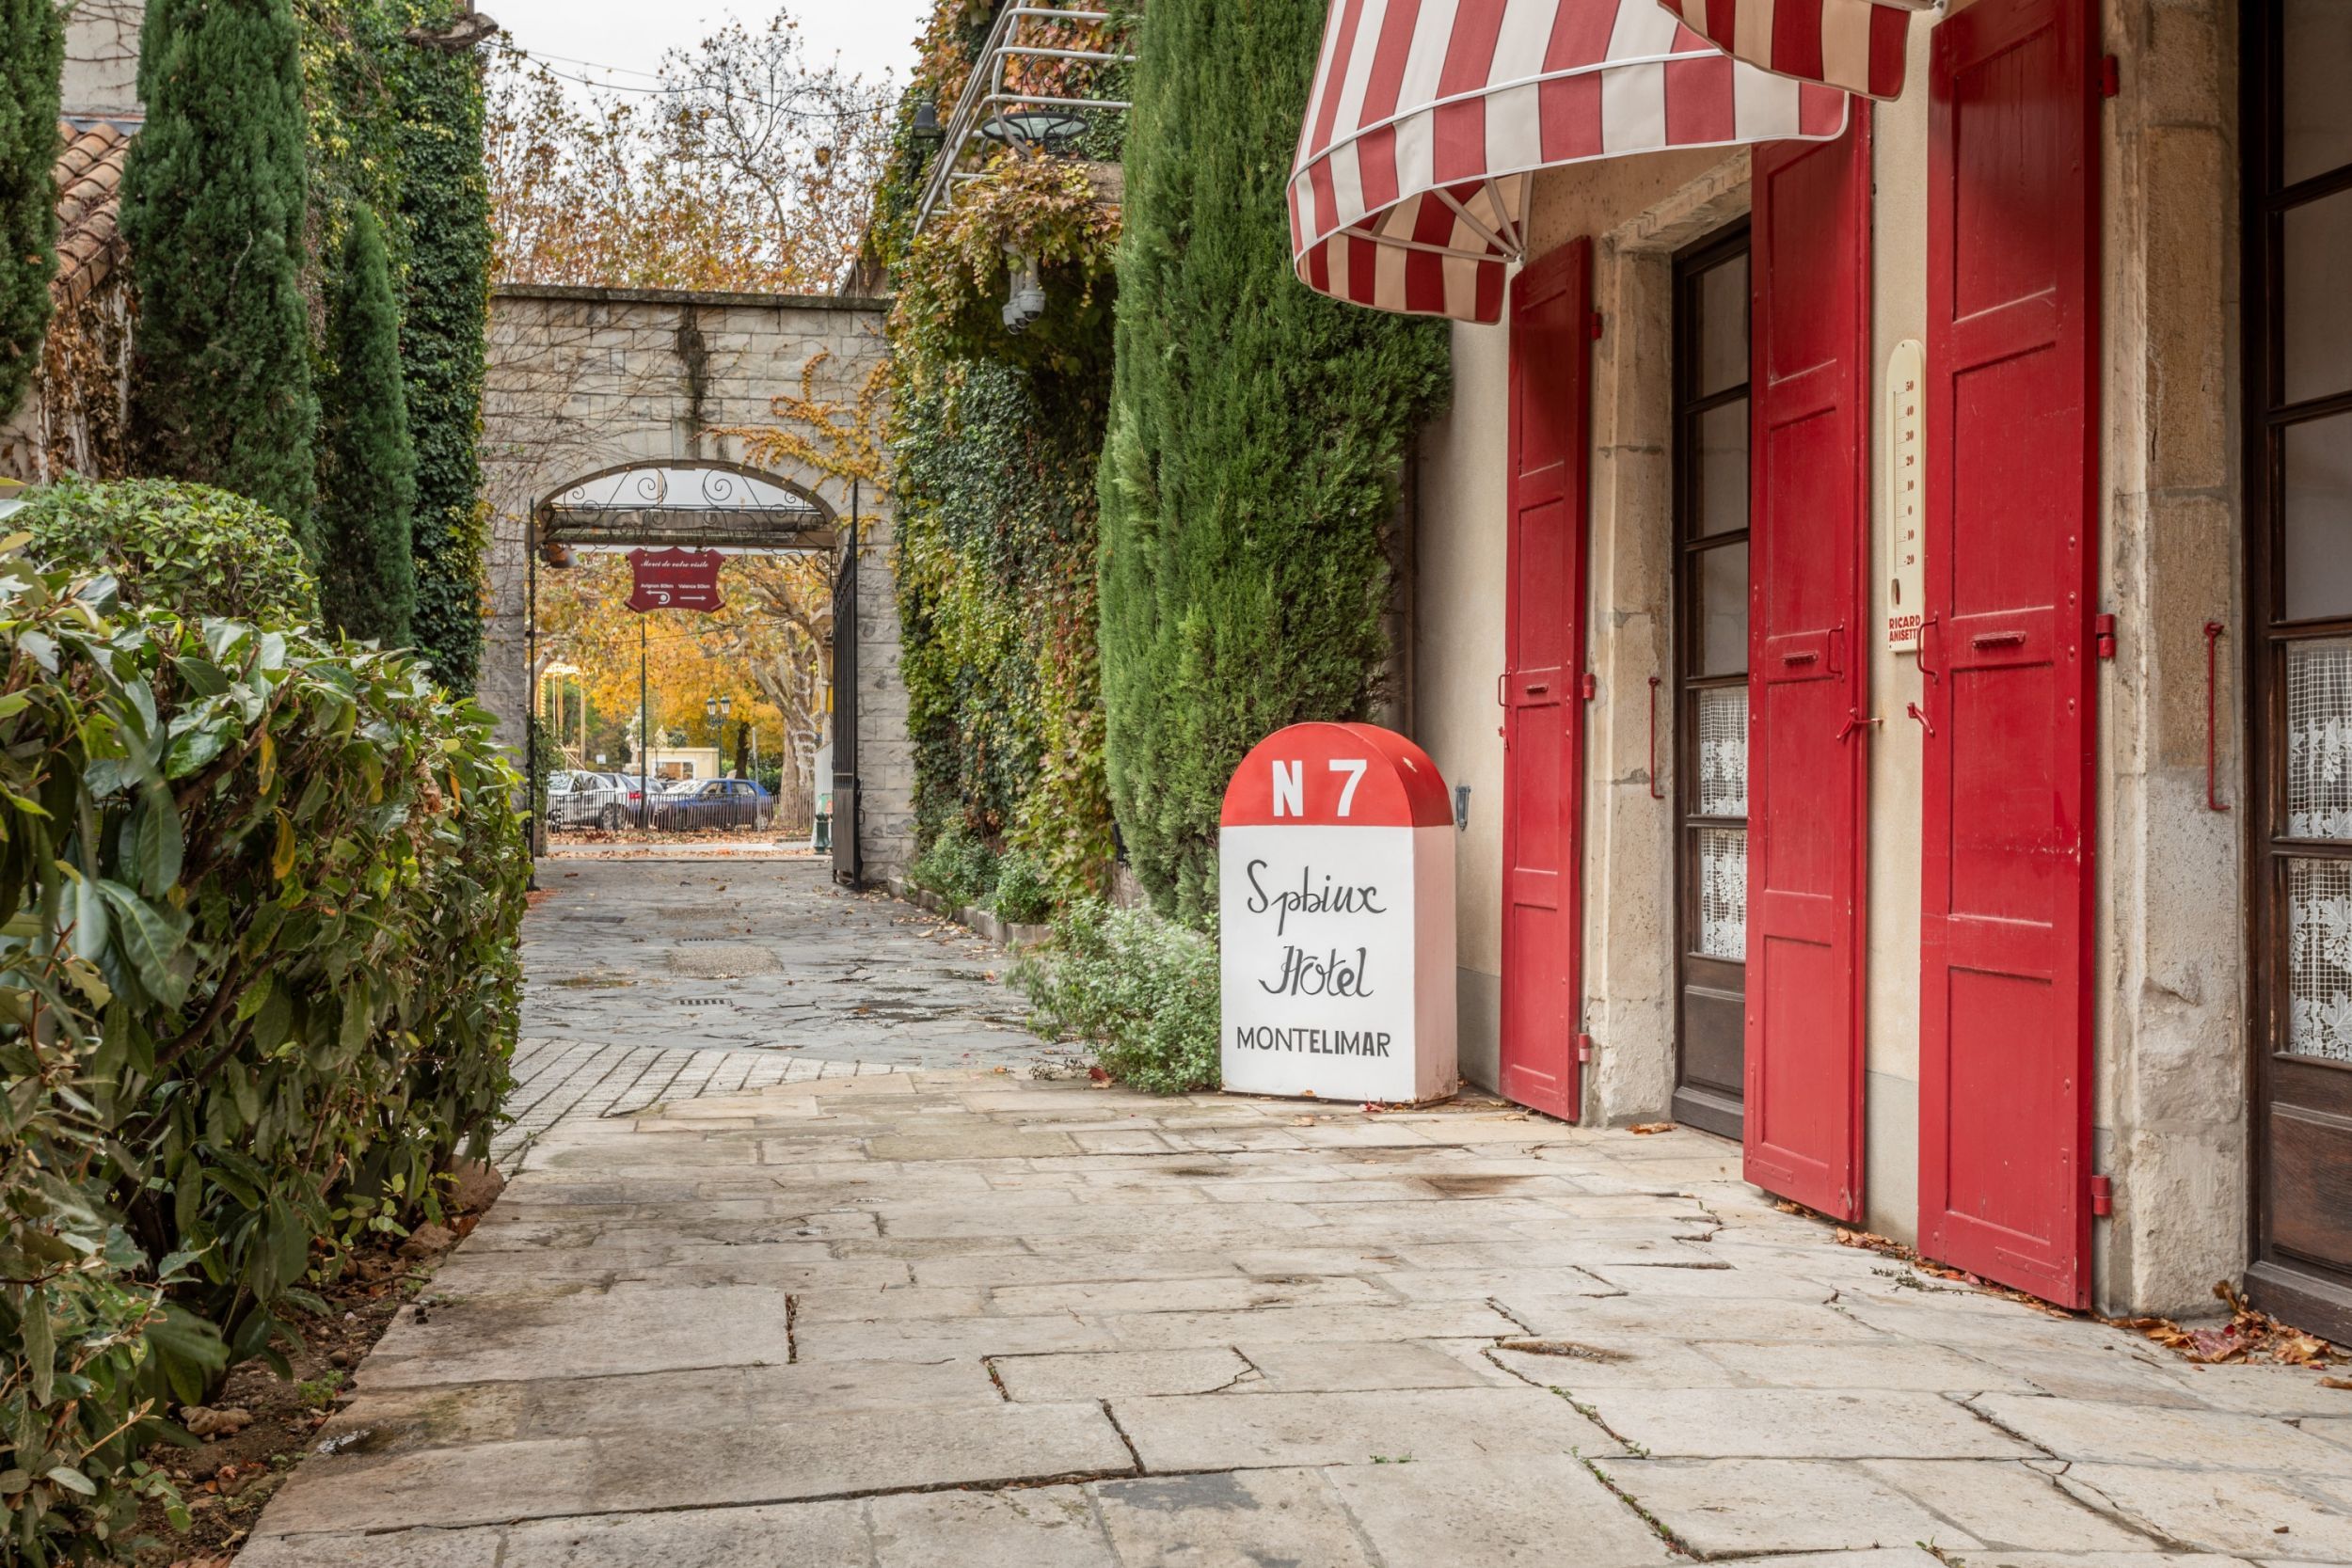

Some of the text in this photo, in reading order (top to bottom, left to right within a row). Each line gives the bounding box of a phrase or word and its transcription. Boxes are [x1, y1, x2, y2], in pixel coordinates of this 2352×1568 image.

[1906, 380, 1914, 391] 50
[1906, 405, 1914, 417] 40
[1906, 430, 1914, 441] 30
[1906, 454, 1914, 466] 20
[1907, 480, 1914, 491] 10
[1907, 505, 1913, 515] 0
[641, 560, 660, 568] Merci
[1888, 615, 1921, 629] RICARD
[1889, 628, 1919, 642] ANISETT
[1272, 759, 1368, 817] N 7
[1236, 1025, 1391, 1057] MONTELIMAR
